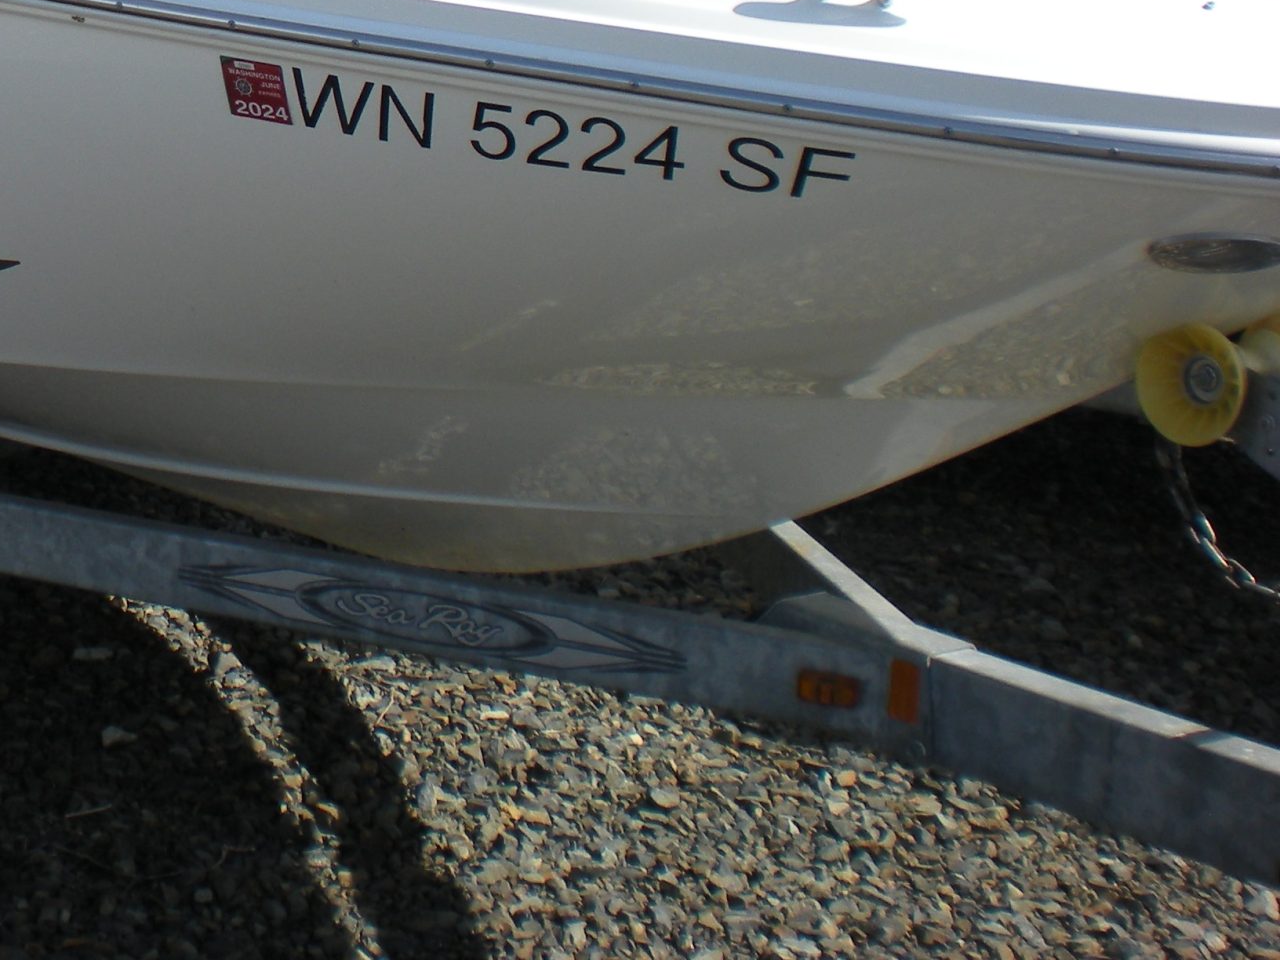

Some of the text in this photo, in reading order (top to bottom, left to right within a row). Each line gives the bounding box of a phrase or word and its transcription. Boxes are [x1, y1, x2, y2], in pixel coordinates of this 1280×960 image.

[227, 67, 281, 82] WASHINGTON
[235, 100, 289, 121] 2024
[292, 67, 856, 197] WN 5224 SF
[337, 593, 503, 646] Sea Ray
